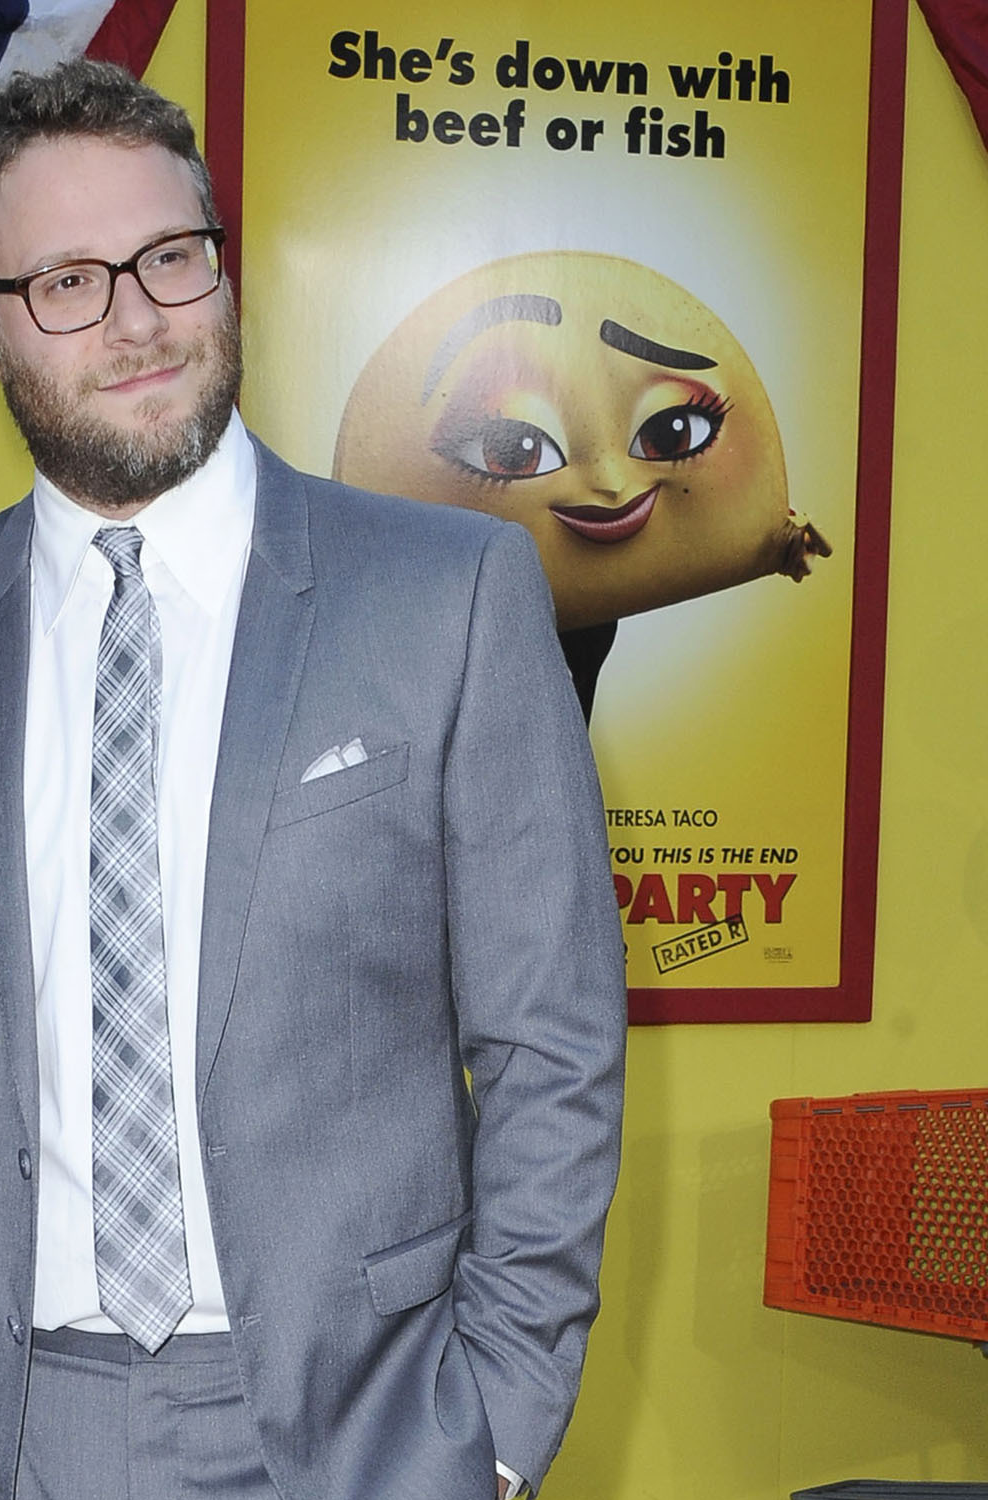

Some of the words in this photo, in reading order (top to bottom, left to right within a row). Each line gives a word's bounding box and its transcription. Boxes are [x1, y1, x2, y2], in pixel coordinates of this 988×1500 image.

[327, 30, 475, 85] She's
[495, 40, 648, 95] down
[667, 51, 790, 103] with
[395, 94, 526, 148] beef
[545, 116, 604, 151] or
[624, 106, 725, 158] fish
[605, 809, 667, 827] TERESA
[671, 809, 718, 827] TACO
[652, 848, 692, 864] THIS
[698, 848, 715, 864] IS
[721, 848, 755, 864] THE
[759, 848, 799, 864] END
[661, 929, 722, 966] RATED
[726, 919, 743, 940] R
